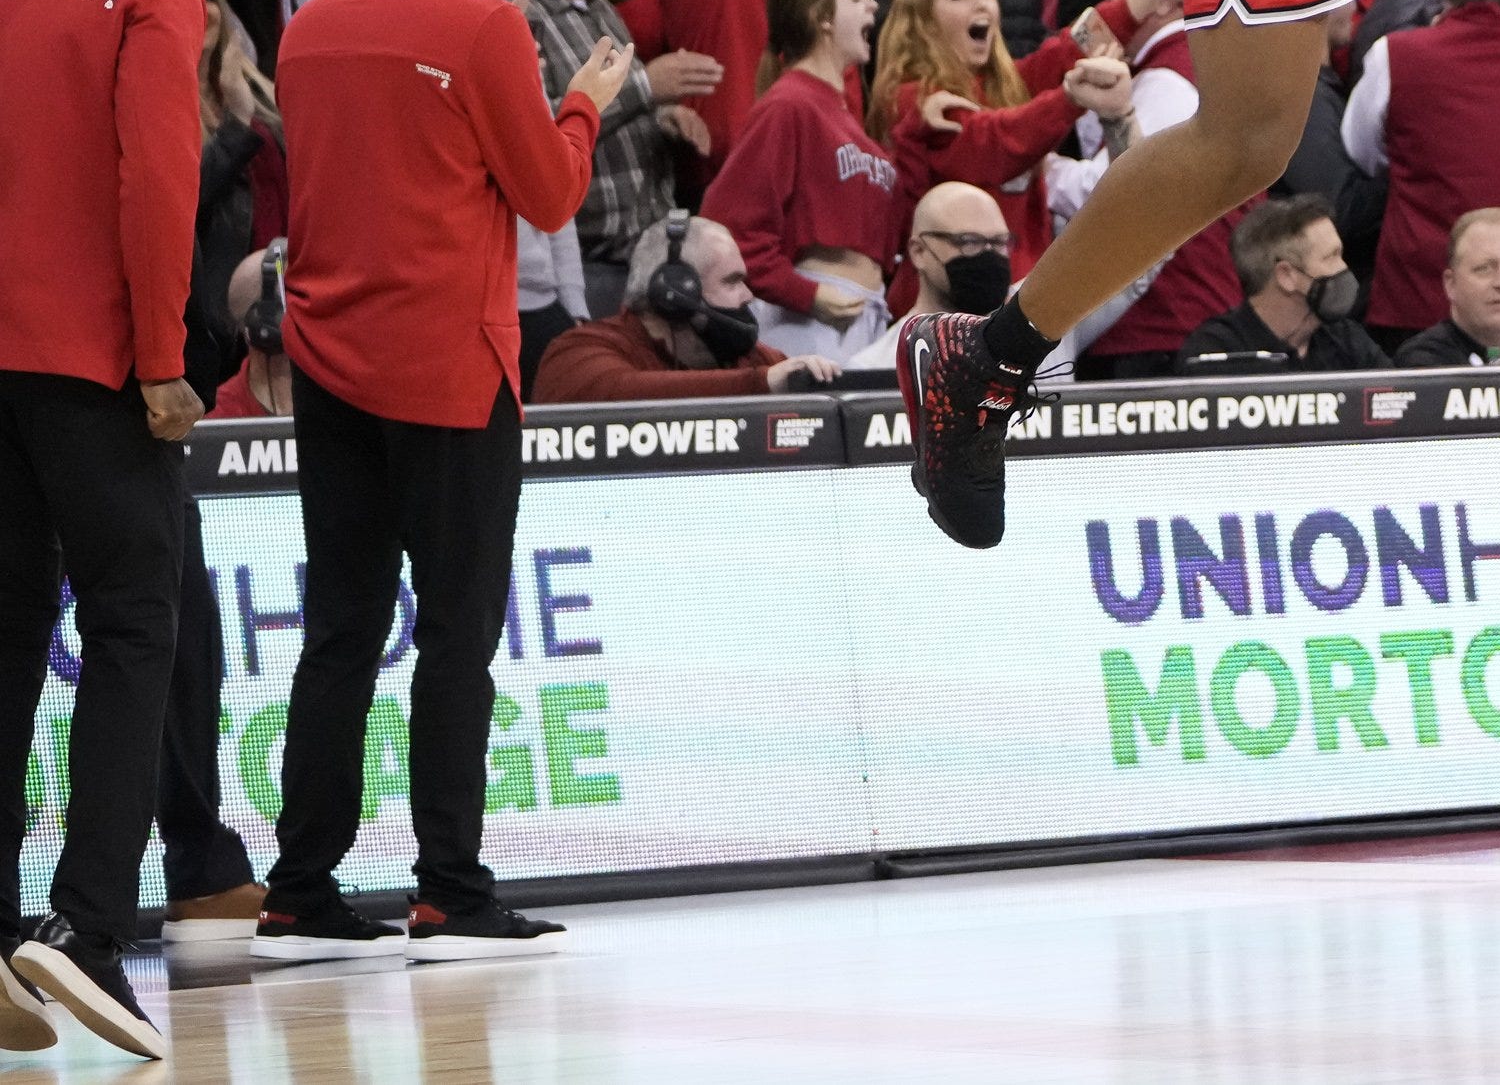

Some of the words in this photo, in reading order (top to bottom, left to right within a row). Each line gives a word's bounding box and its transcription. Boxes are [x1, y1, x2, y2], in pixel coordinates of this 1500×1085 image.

[1062, 397, 1209, 438] ELECTRIC
[1217, 392, 1340, 430] POWER
[521, 425, 596, 463] TRIC
[605, 418, 740, 457] POWER
